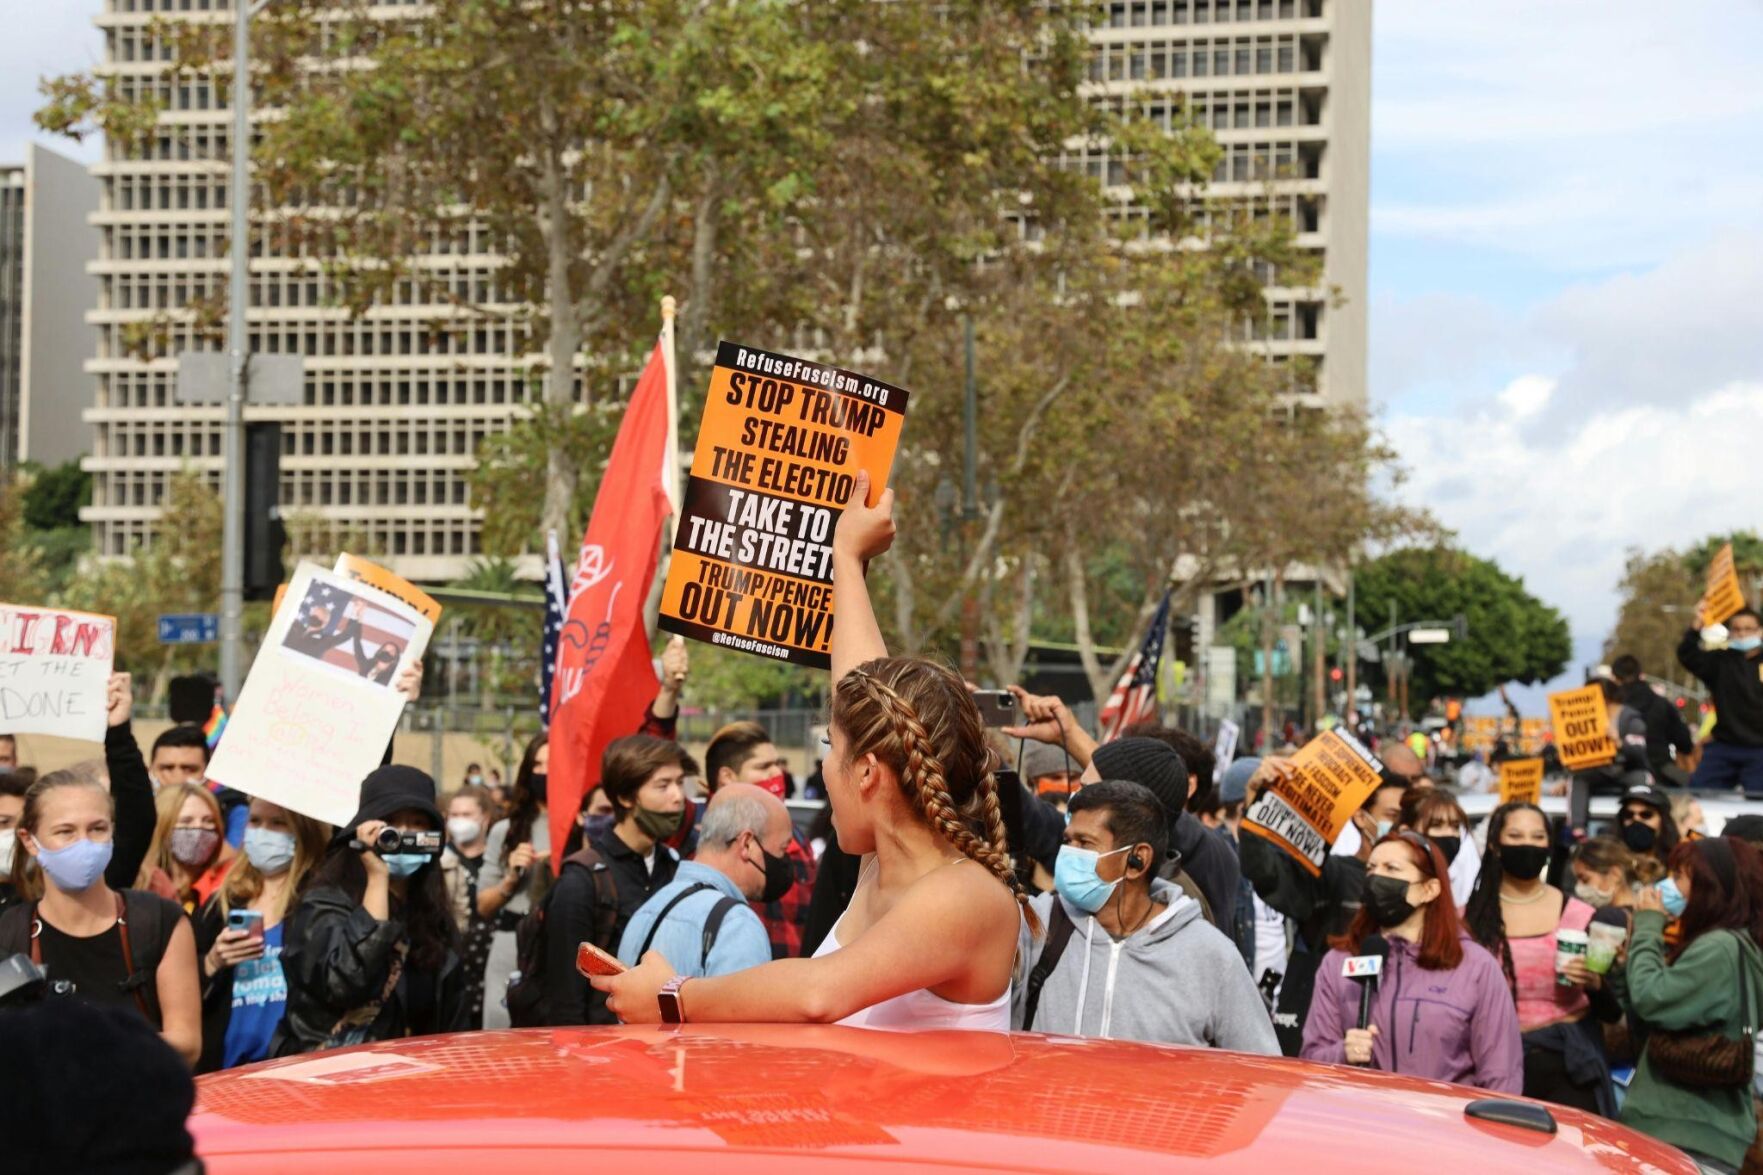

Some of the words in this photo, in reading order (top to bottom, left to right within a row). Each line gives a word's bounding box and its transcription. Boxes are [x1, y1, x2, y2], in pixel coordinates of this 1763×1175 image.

[737, 349, 889, 405] RefuseFascism.org
[726, 372, 794, 415] STOP
[799, 389, 886, 437] TRUMP
[741, 417, 850, 465] STEALING
[712, 446, 755, 483] THE
[758, 458, 857, 505] ELECTIO
[726, 491, 794, 535] TAKE
[798, 506, 831, 543] TO
[688, 516, 736, 559] THE
[738, 529, 835, 580] STREET
[699, 561, 832, 611] TRUMP/PENCE
[679, 582, 743, 630] OUT
[746, 599, 834, 650] NOW!
[41, 662, 86, 676] THE
[712, 631, 789, 659] @RefuseFascism
[1, 687, 86, 720] DONE
[1565, 718, 1598, 738] OUT
[1562, 735, 1611, 757] NOW!
[1257, 805, 1286, 829] OUT
